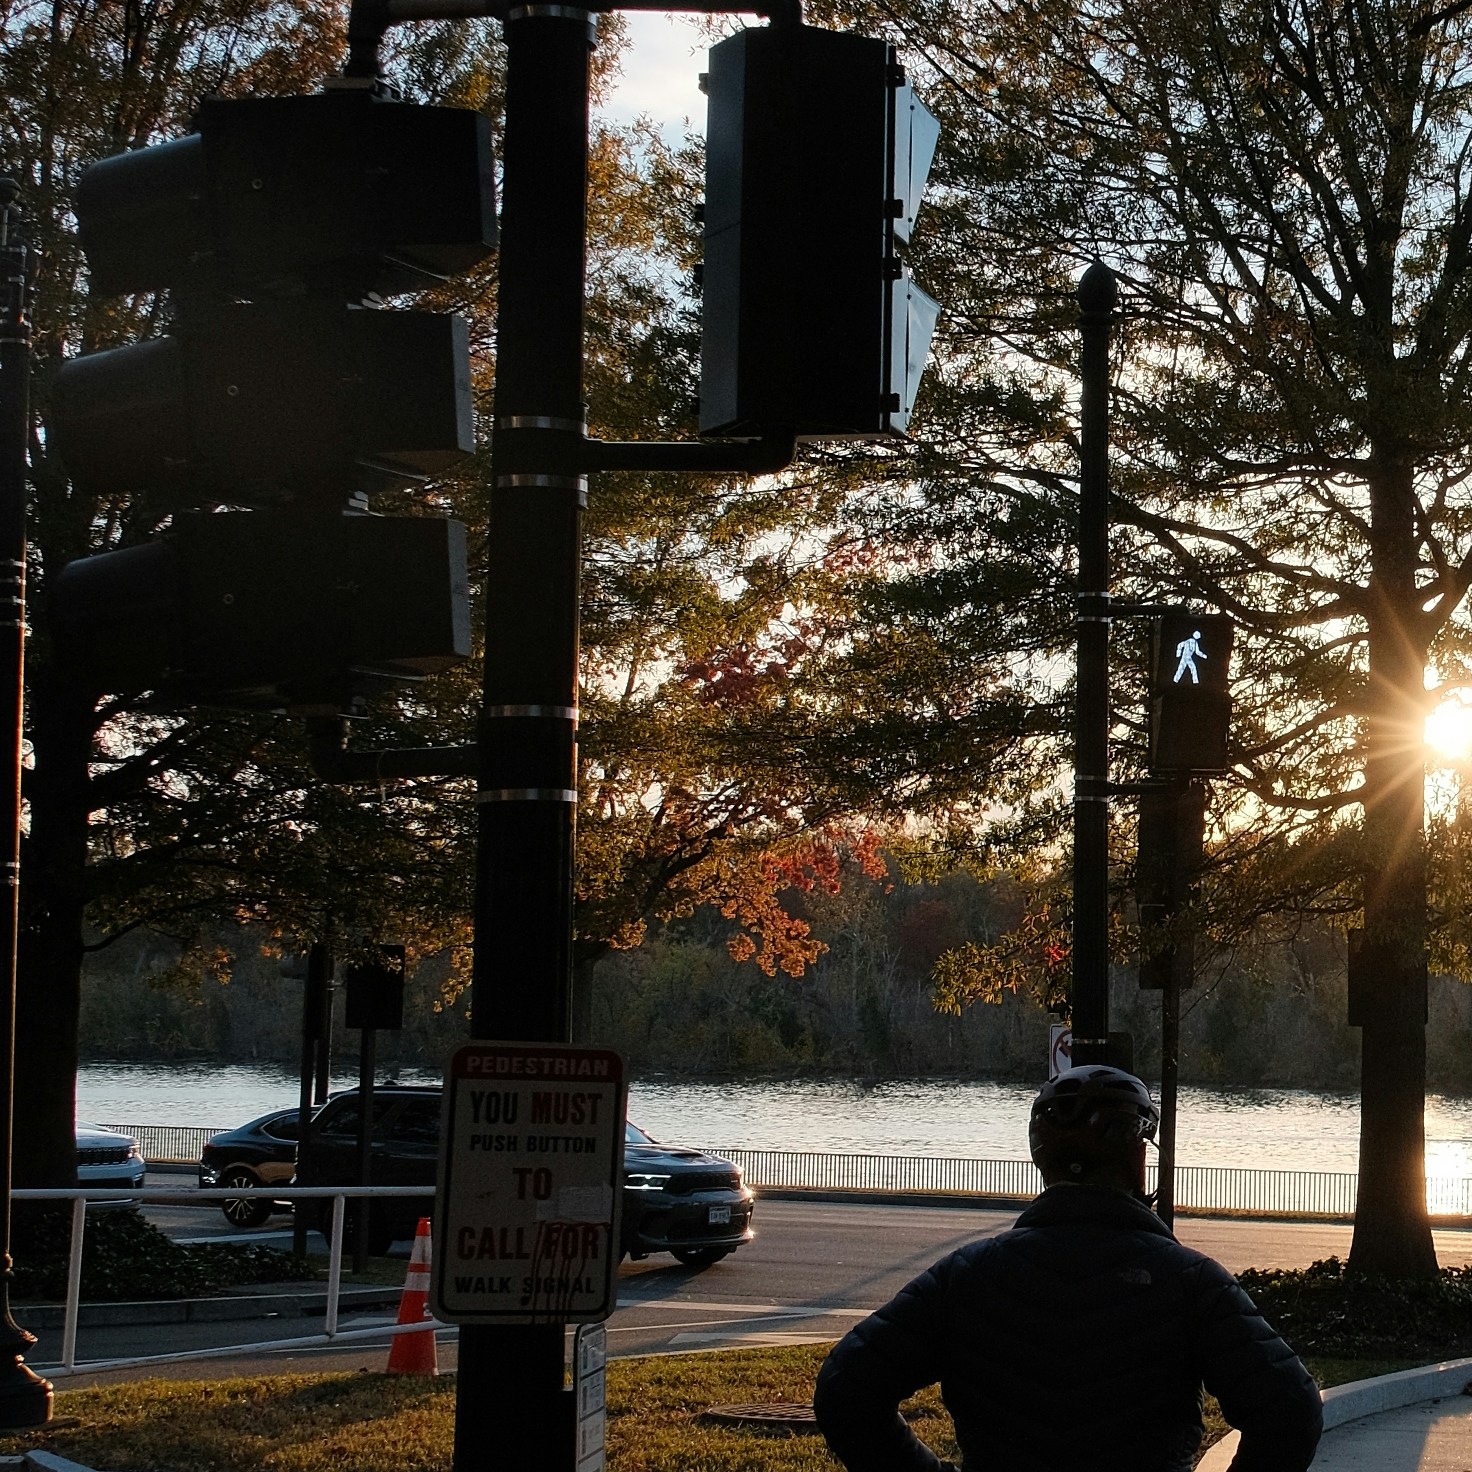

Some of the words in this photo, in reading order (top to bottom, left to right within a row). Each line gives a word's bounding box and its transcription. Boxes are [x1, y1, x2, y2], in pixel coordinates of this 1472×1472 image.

[466, 1055, 609, 1076] PEDESTRIAN
[469, 1091, 518, 1124] YOU
[530, 1091, 602, 1125] MUST
[469, 1134, 518, 1152] PUSH
[526, 1135, 596, 1154] BUTTON
[512, 1167, 553, 1201] TO
[457, 1226, 530, 1260] CALL
[543, 1224, 600, 1260] FOR
[455, 1276, 512, 1295] WALK
[521, 1276, 596, 1295] SIGNAL
